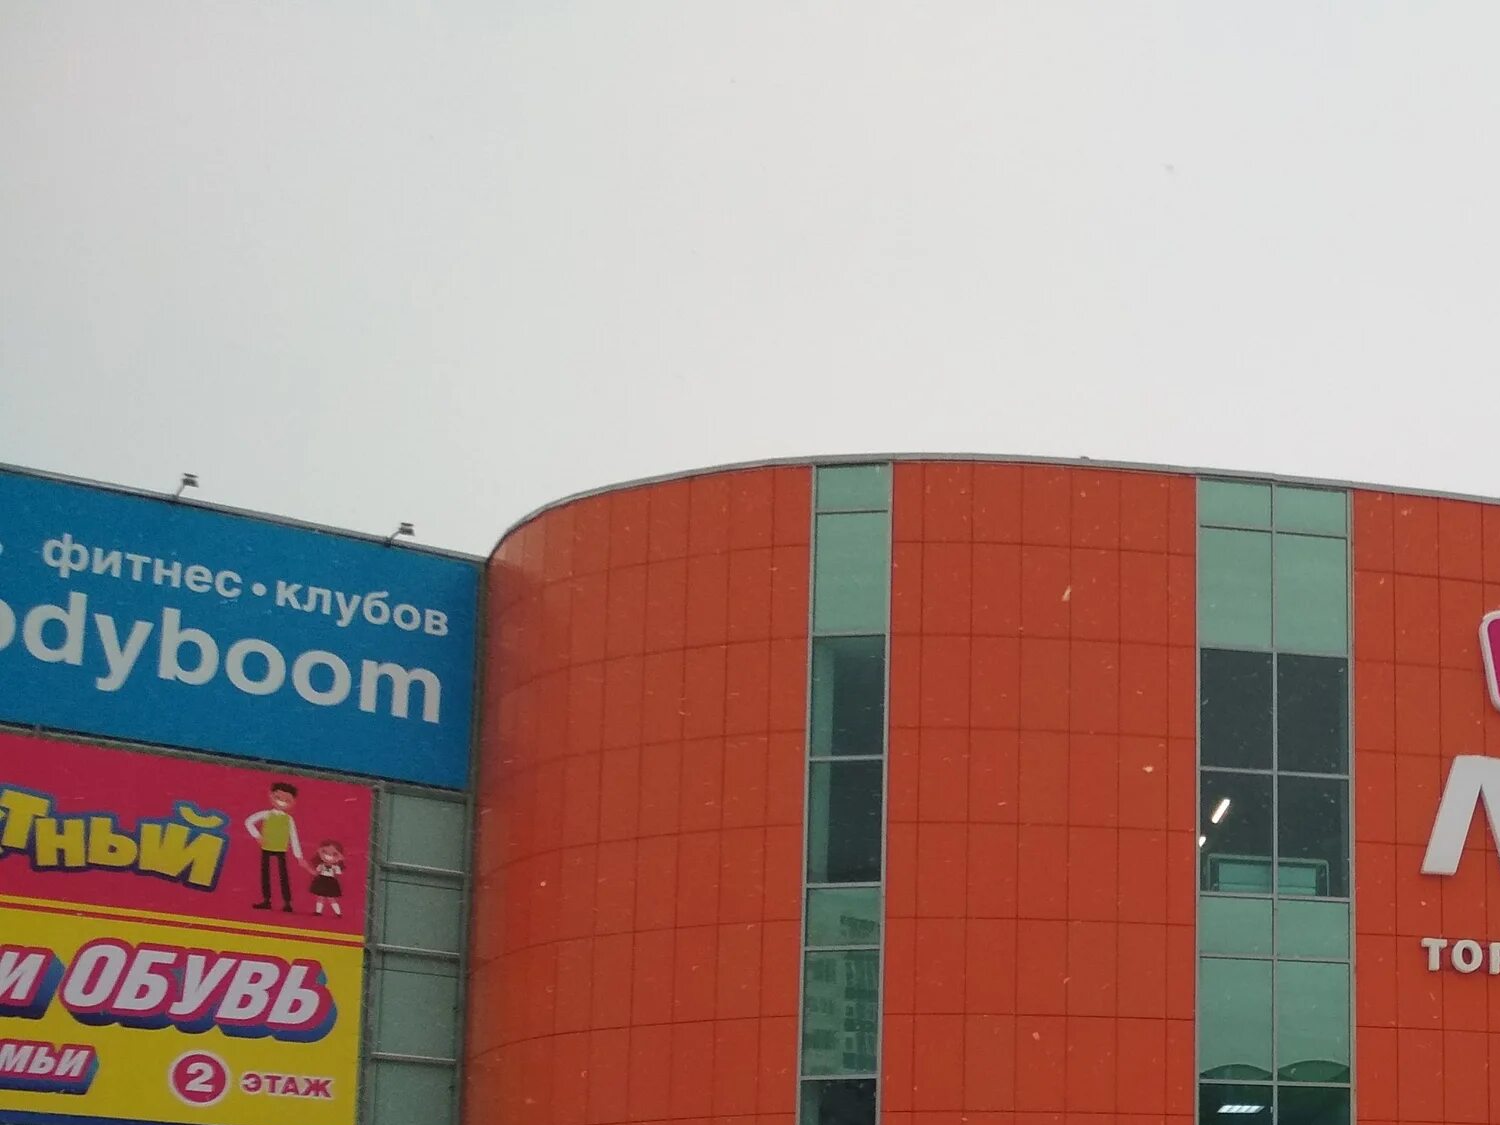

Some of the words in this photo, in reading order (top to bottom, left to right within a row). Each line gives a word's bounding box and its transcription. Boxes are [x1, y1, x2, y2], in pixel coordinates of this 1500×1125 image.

[64, 944, 323, 1028] ОБУВЬ
[0, 1043, 89, 1077] МЬИ
[186, 1062, 213, 1092] 2
[242, 1073, 332, 1098] ЭТАЖ
